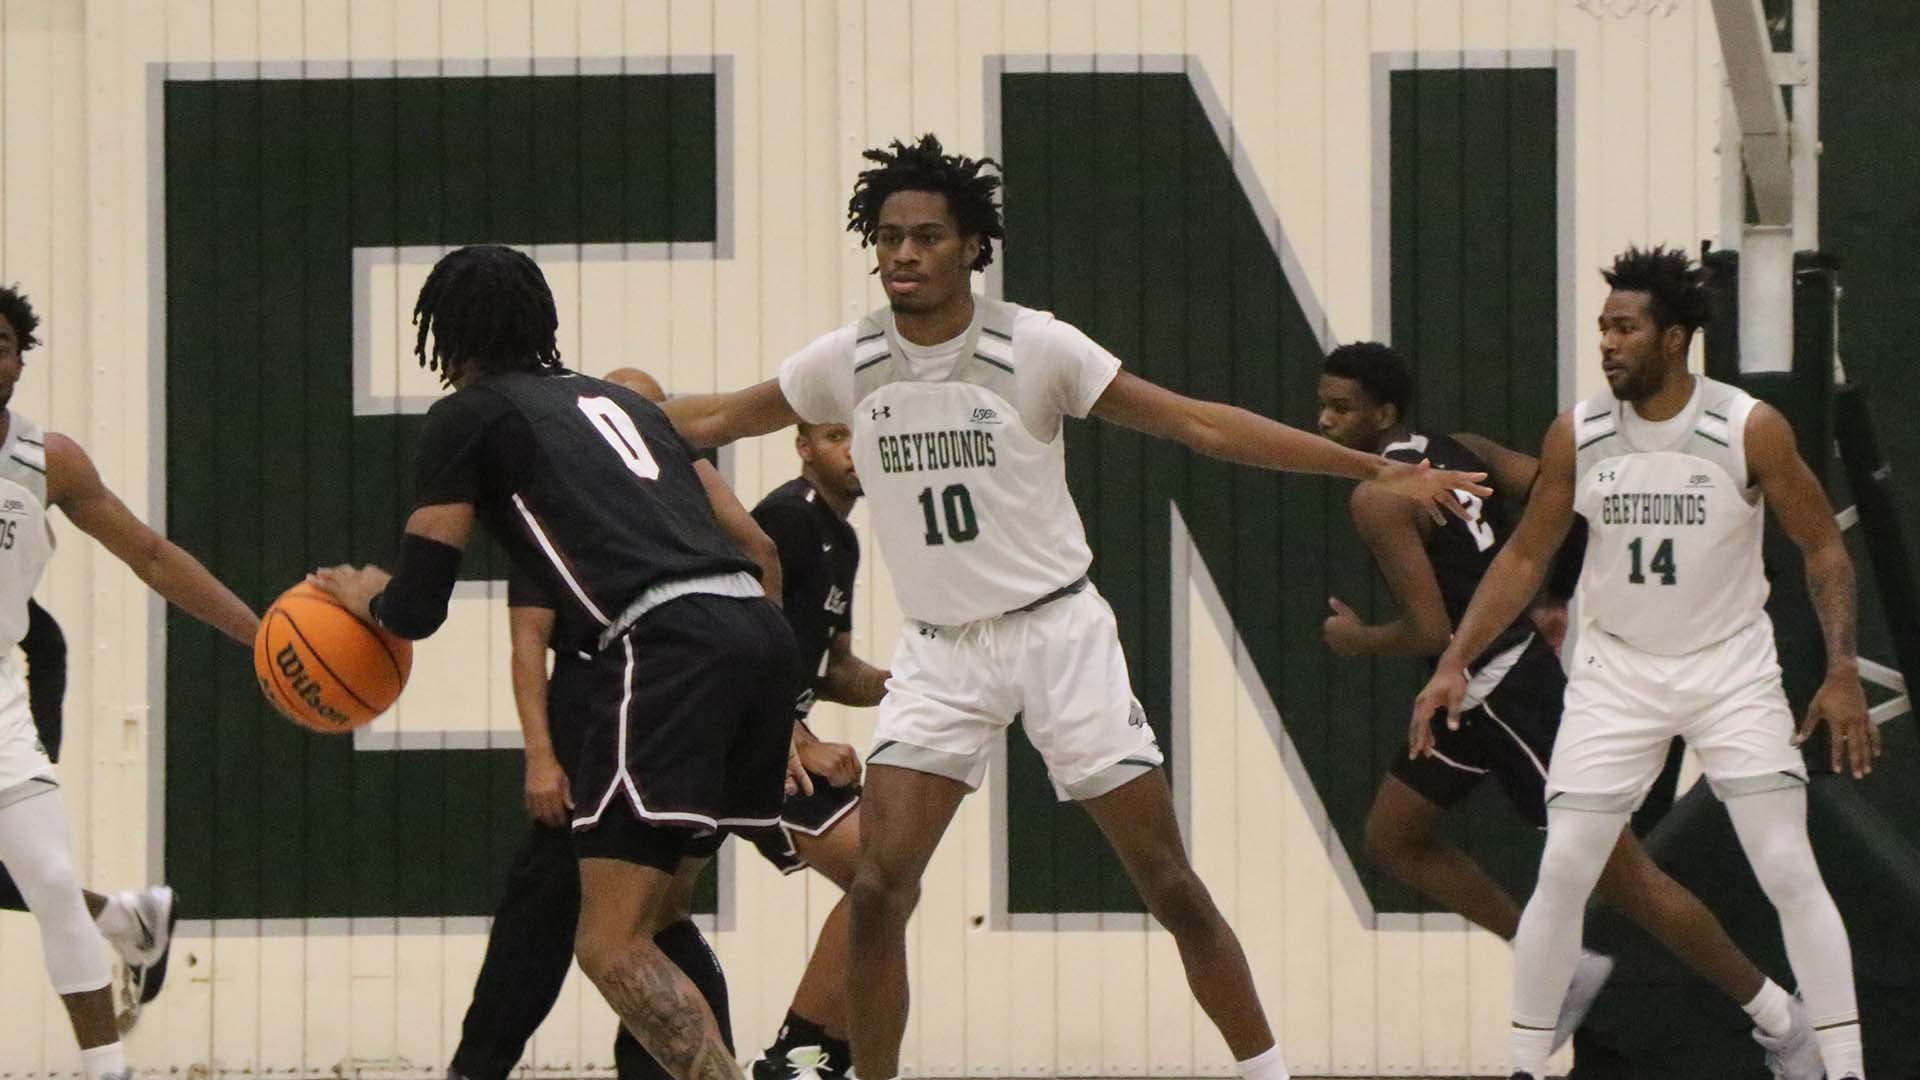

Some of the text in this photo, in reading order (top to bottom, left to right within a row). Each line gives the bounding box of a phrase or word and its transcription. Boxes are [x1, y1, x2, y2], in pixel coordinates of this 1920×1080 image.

[576, 395, 661, 481] 0
[878, 429, 997, 473] GREYHOUNDS
[918, 483, 979, 546] 10
[1452, 488, 1496, 553] 2
[1602, 493, 1706, 525] GREYHOUNDS
[1628, 537, 1677, 585] 14
[276, 642, 351, 725] Wilson
